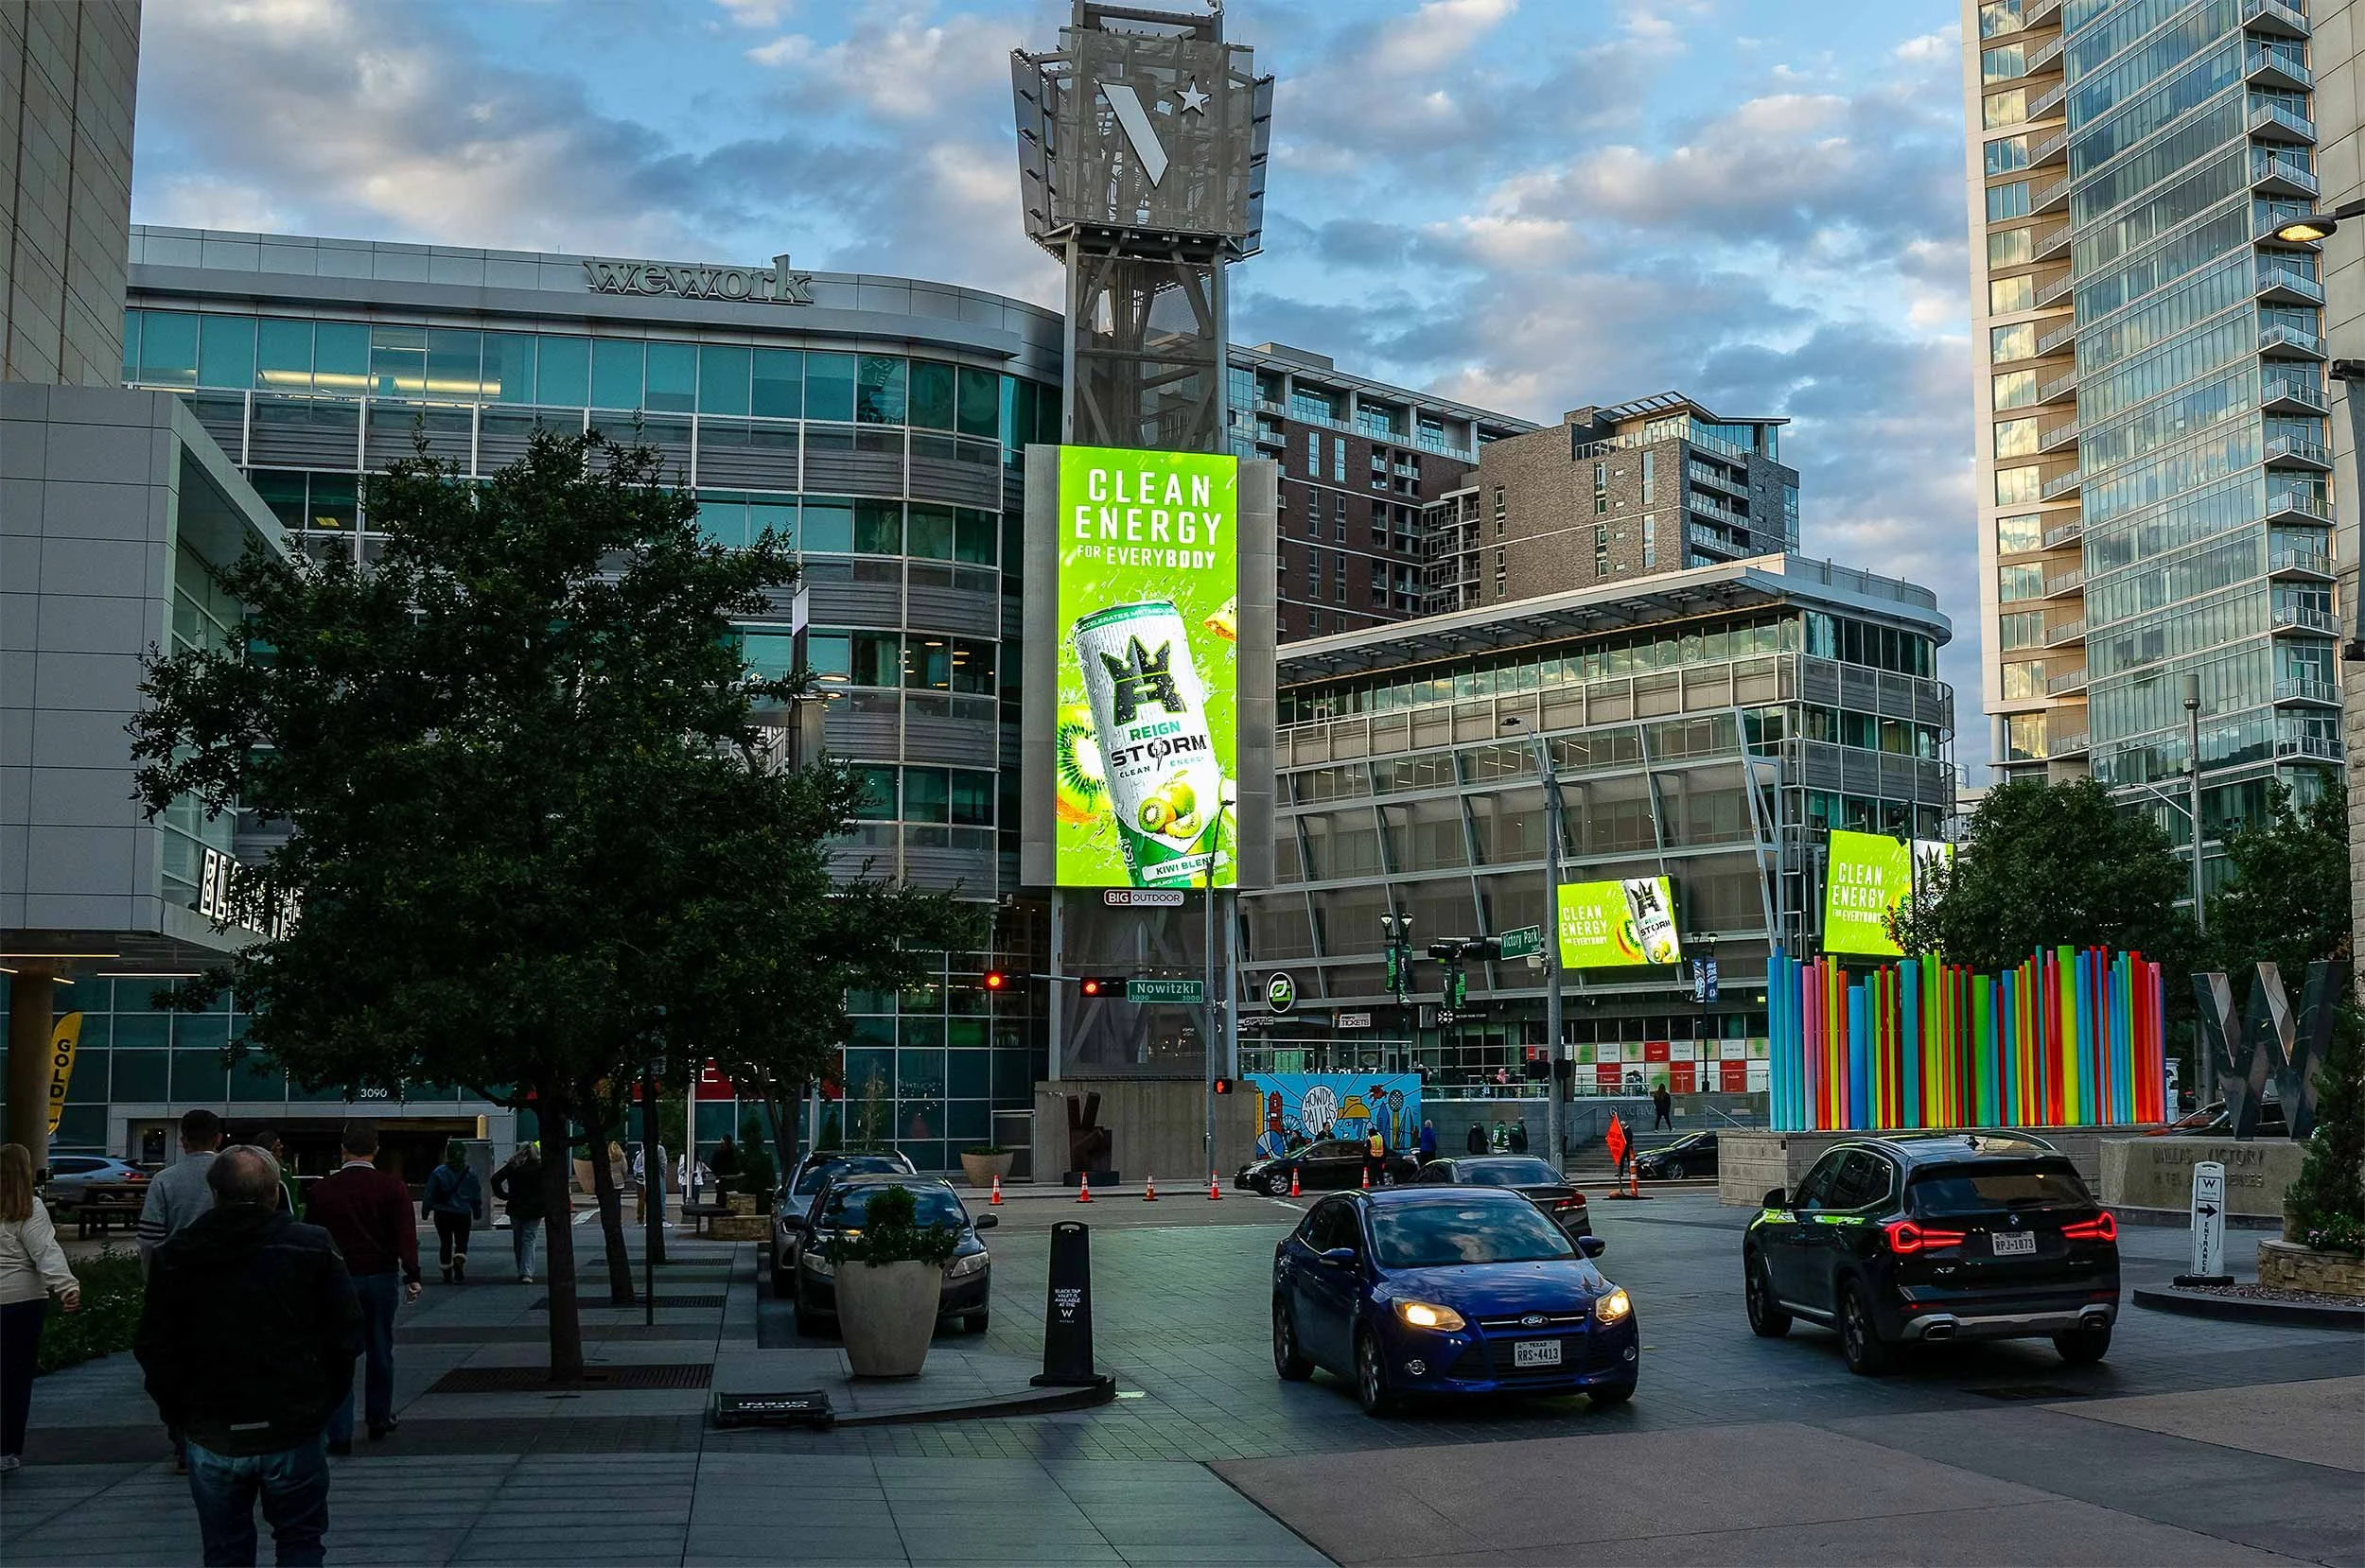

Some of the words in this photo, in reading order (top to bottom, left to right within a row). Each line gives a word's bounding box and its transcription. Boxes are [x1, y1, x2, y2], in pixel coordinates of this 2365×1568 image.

[583, 253, 815, 304] wework
[1088, 468, 1210, 508] CLEAN
[1075, 505, 1222, 546] ENERGY
[1077, 544, 1101, 559] FOR
[1106, 546, 1216, 569] EVERYBODY
[1129, 721, 1181, 741] REIGN
[1111, 734, 1207, 768] STORM
[1119, 765, 1150, 778] CLEAN
[1156, 864, 1180, 876] KIWI
[1181, 857, 1215, 870] BLEN
[1838, 862, 1883, 887] CLEAN
[1108, 893, 1129, 903] BIG
[1132, 893, 1181, 902] OUTDOOR
[1831, 884, 1885, 909] ENERGY
[1562, 905, 1603, 921] CLEAN
[1523, 928, 1538, 944] Park
[1561, 920, 1607, 938] ENERGY
[1137, 983, 1194, 994] Nowitzki
[1244, 1016, 1274, 1026] OPTIC
[1341, 1019, 1370, 1027] TICKETS
[49, 1038, 72, 1098] GOLD
[360, 1088, 388, 1098] 3090
[1305, 1088, 1332, 1108] HOWDY
[1303, 1102, 1337, 1135] DALLAS
[2152, 1145, 2194, 1165] DALLAS
[2205, 1144, 2264, 1166] VICTORY
[2203, 1179, 2216, 1188] W
[1061, 1309, 1073, 1317] W
